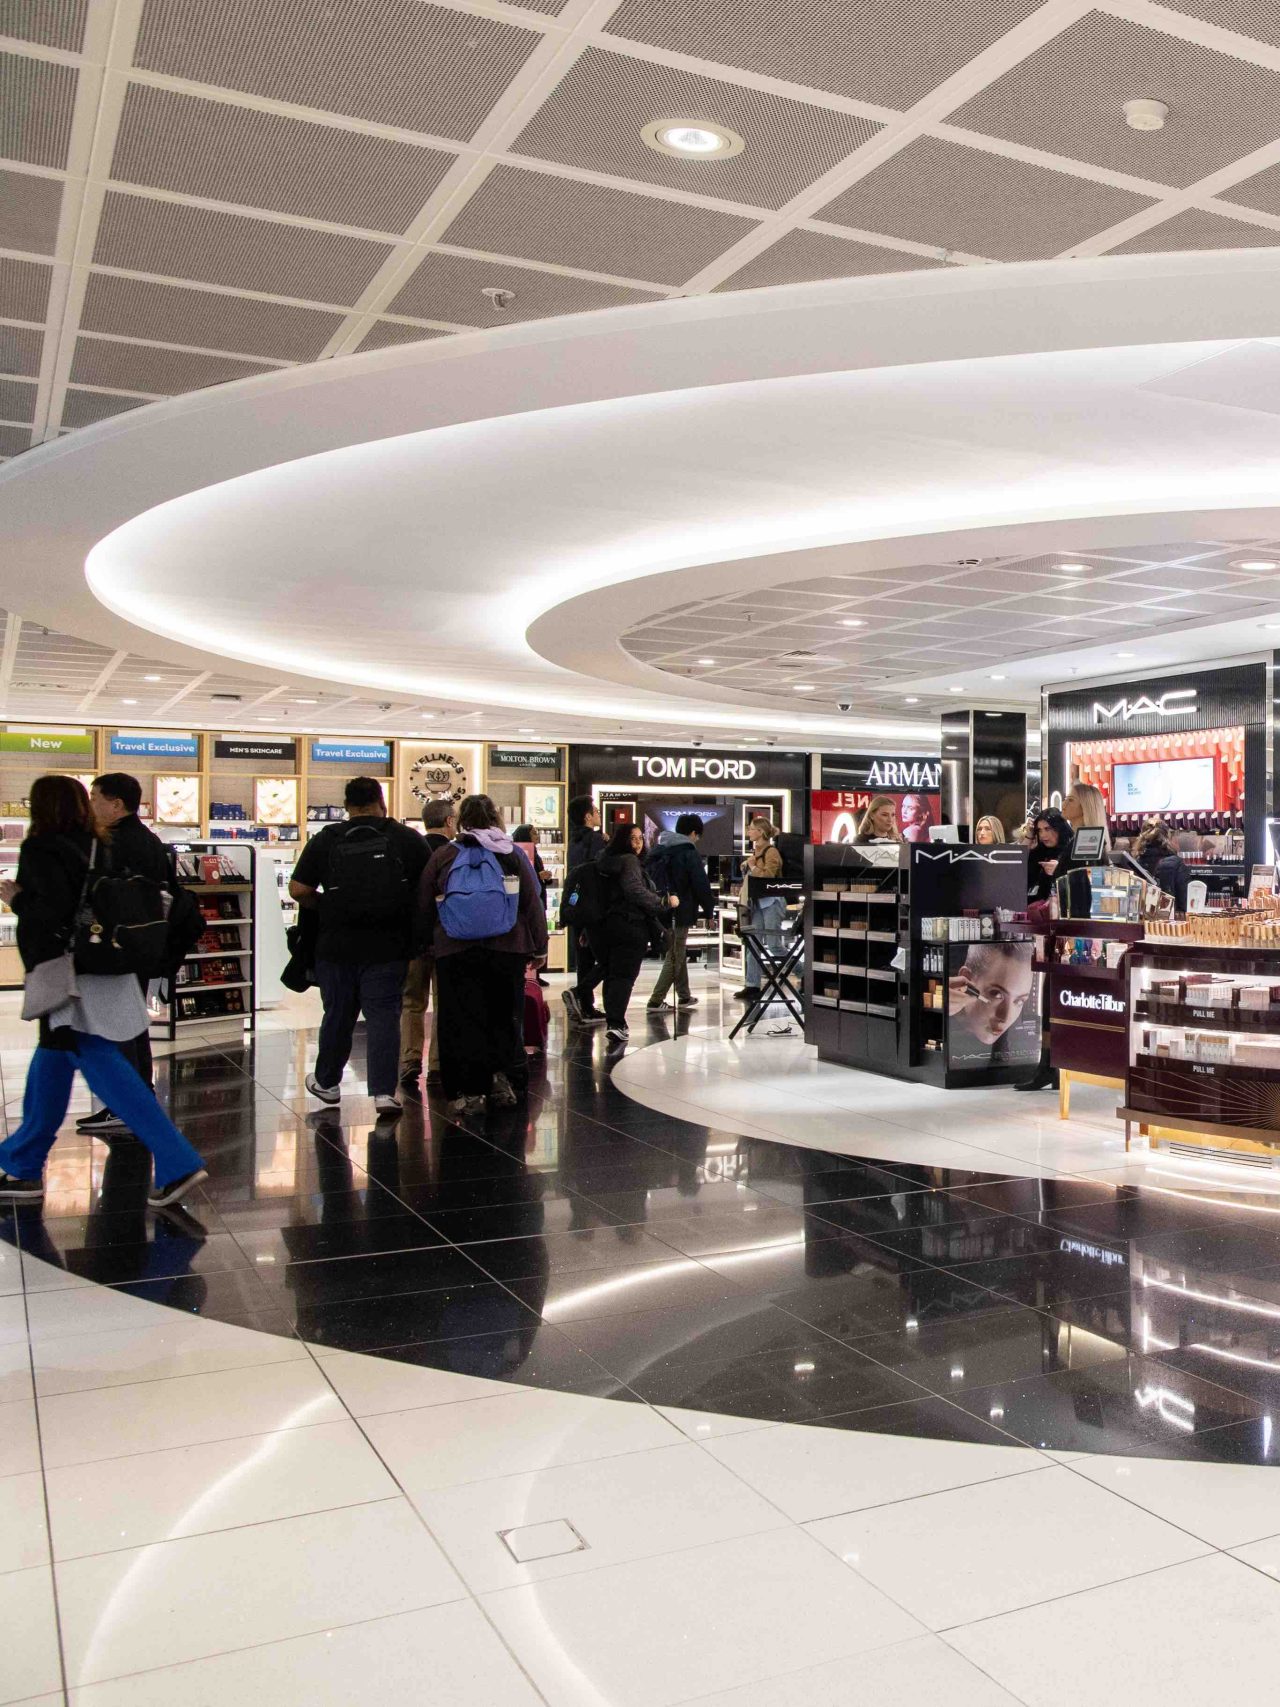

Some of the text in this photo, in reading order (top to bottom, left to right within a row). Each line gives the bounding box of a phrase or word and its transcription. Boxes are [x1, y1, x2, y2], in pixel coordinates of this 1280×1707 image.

[30, 737, 63, 750] New
[114, 741, 195, 752] Travel Exclusive
[316, 749, 388, 760] Travel Exclusive
[500, 755, 556, 764] MOLTON BROWN
[632, 756, 756, 780] TOM FORD
[1059, 989, 1126, 1013] CharlotteTilbur
[1193, 1009, 1215, 1018] PULL ME
[1193, 1065, 1215, 1075] PULL ME
